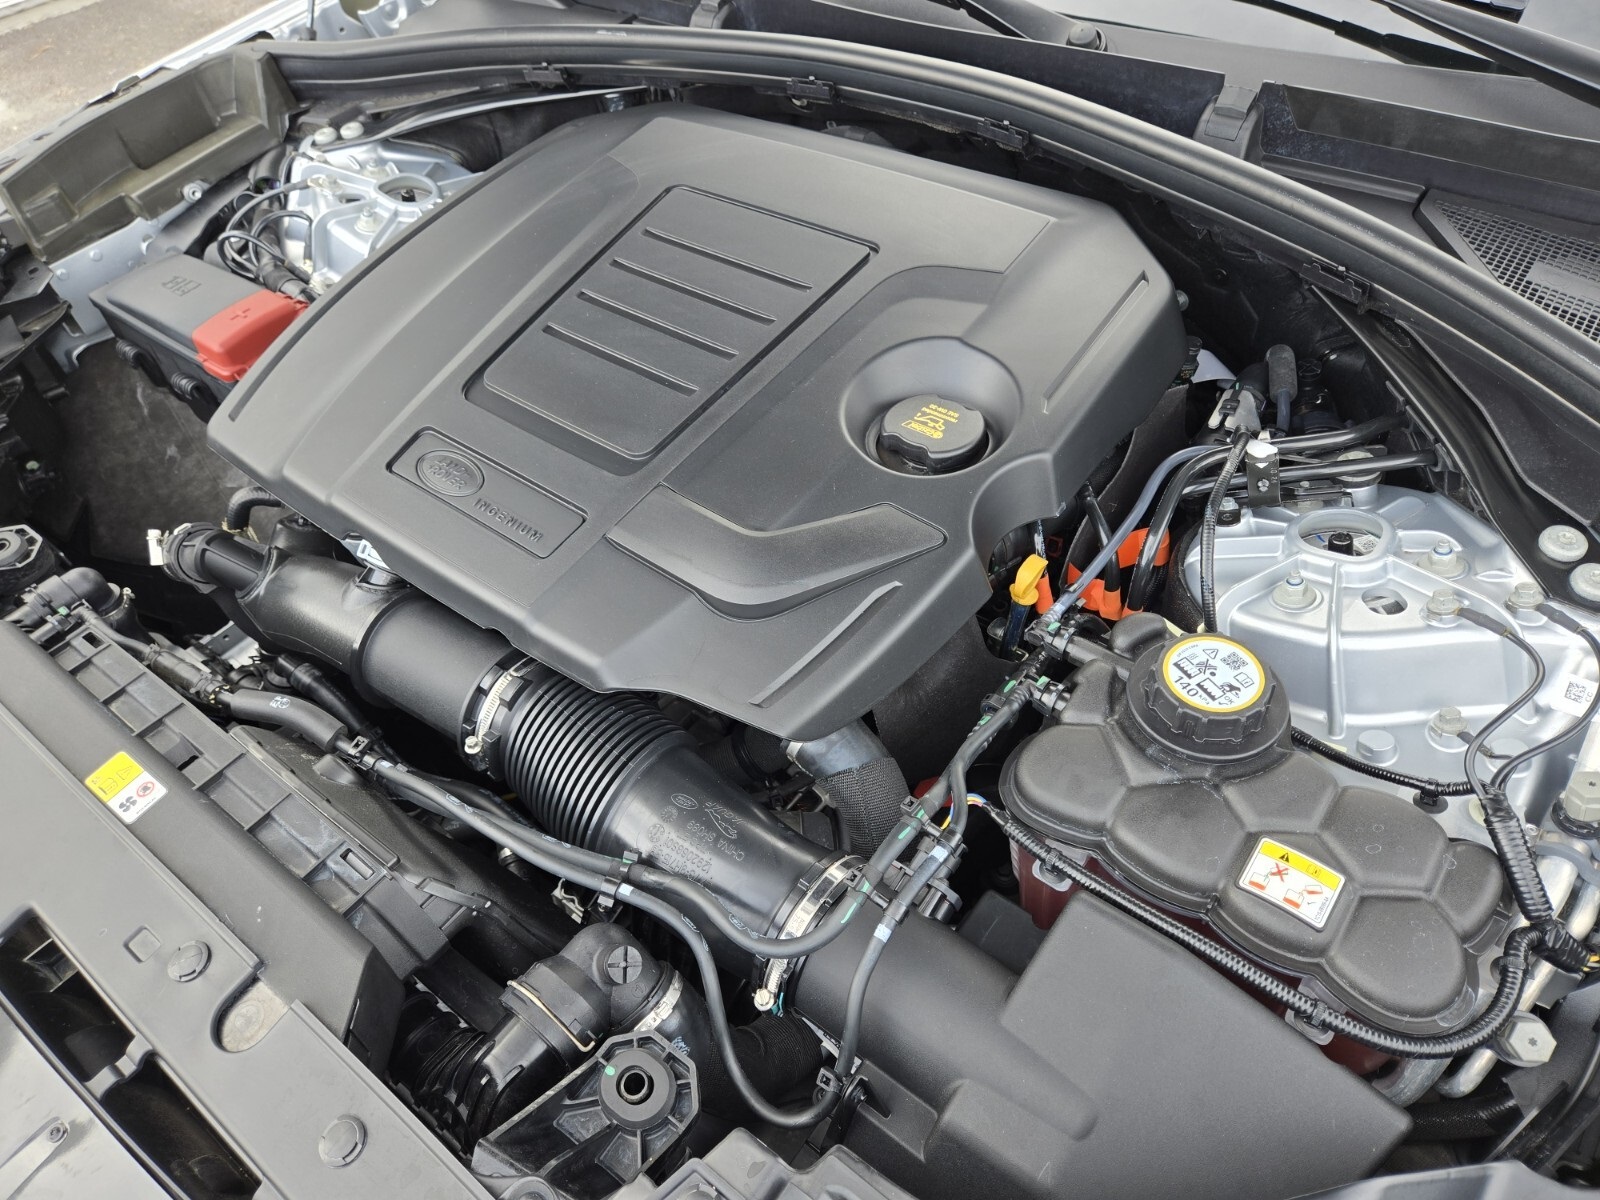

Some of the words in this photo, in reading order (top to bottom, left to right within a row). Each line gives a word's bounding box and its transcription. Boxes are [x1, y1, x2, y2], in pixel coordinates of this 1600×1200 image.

[429, 464, 467, 490] ROVER
[473, 497, 543, 543] INGENIUM
[1174, 675, 1199, 696] 140
[1224, 695, 1235, 705] OK
[717, 838, 745, 862] CHINA
